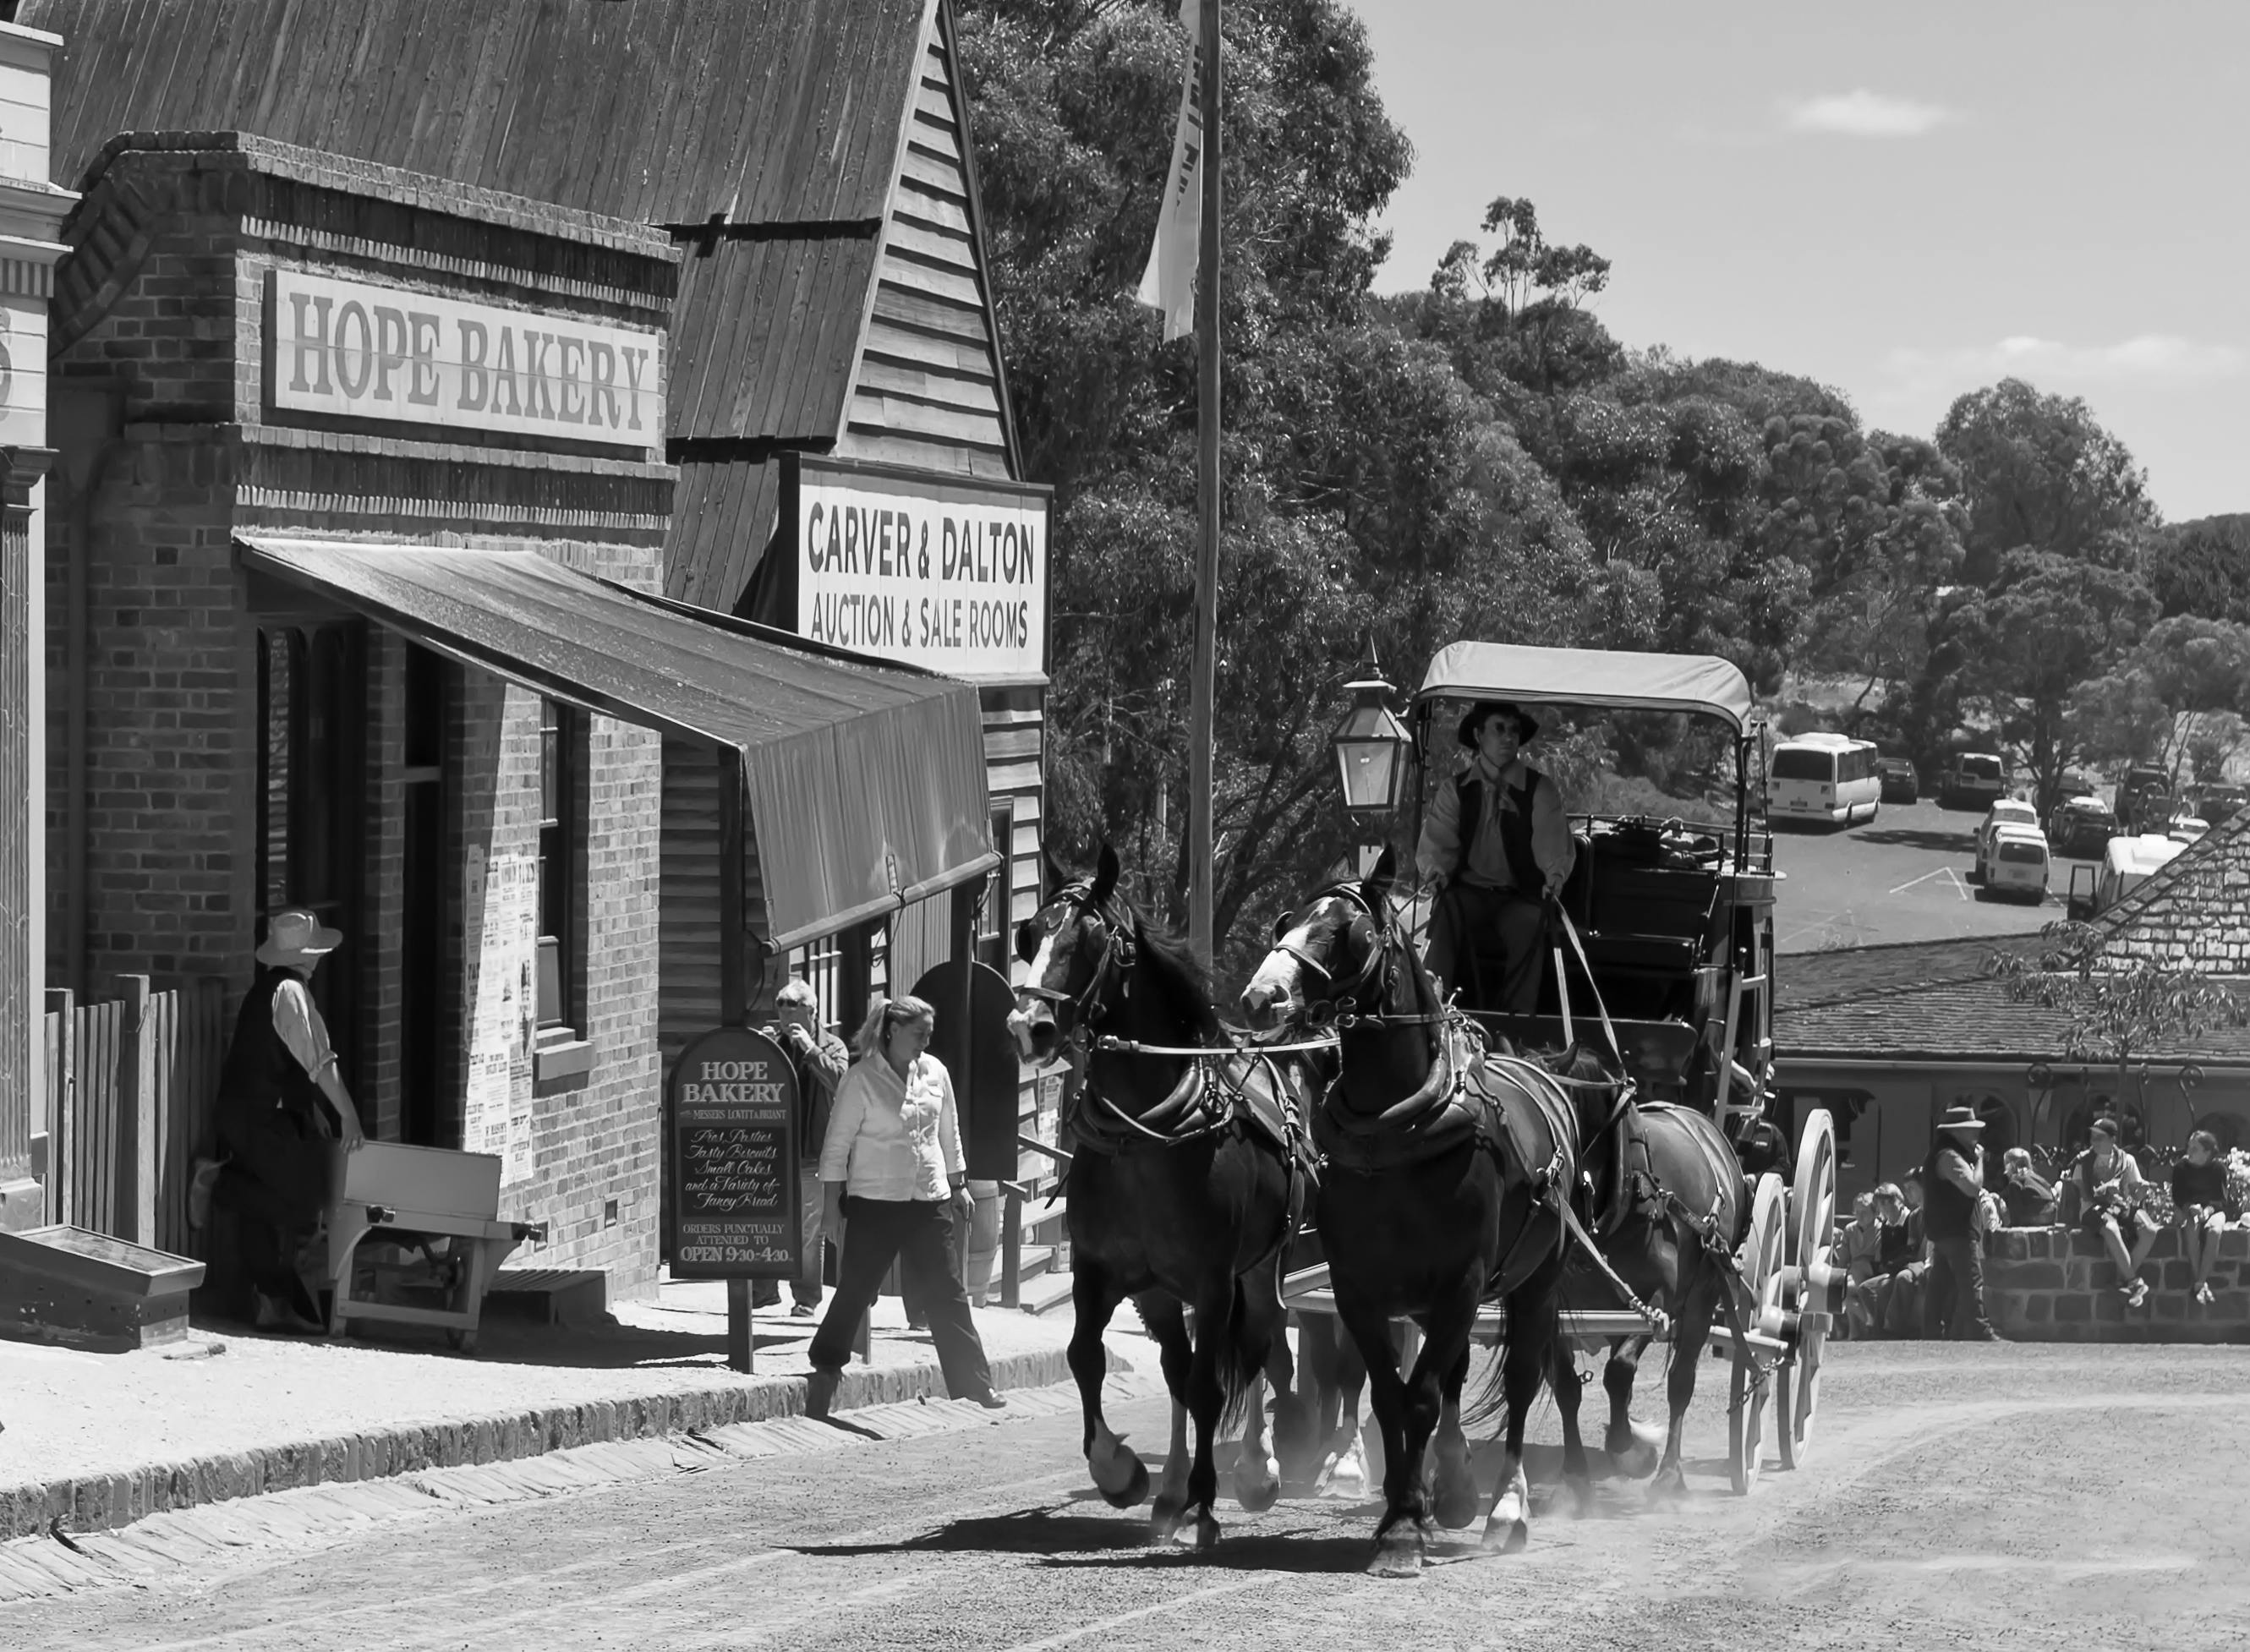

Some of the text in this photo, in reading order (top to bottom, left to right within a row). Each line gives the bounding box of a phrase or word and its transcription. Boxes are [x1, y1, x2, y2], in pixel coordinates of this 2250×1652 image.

[288, 292, 649, 432] HOPE BAKERY
[807, 501, 1034, 585] CARVER & DALTON
[810, 592, 1028, 649] AUCTION & SALE ROOMS
[700, 1061, 768, 1080] HOPE
[682, 1083, 785, 1103] BAKERY
[685, 1178, 709, 1191] and
[763, 1178, 780, 1195] of
[682, 1223, 785, 1234] ORDERS PUNCTUALLY
[696, 1235, 769, 1245] ATTENDED TO
[680, 1246, 724, 1262] OPEN
